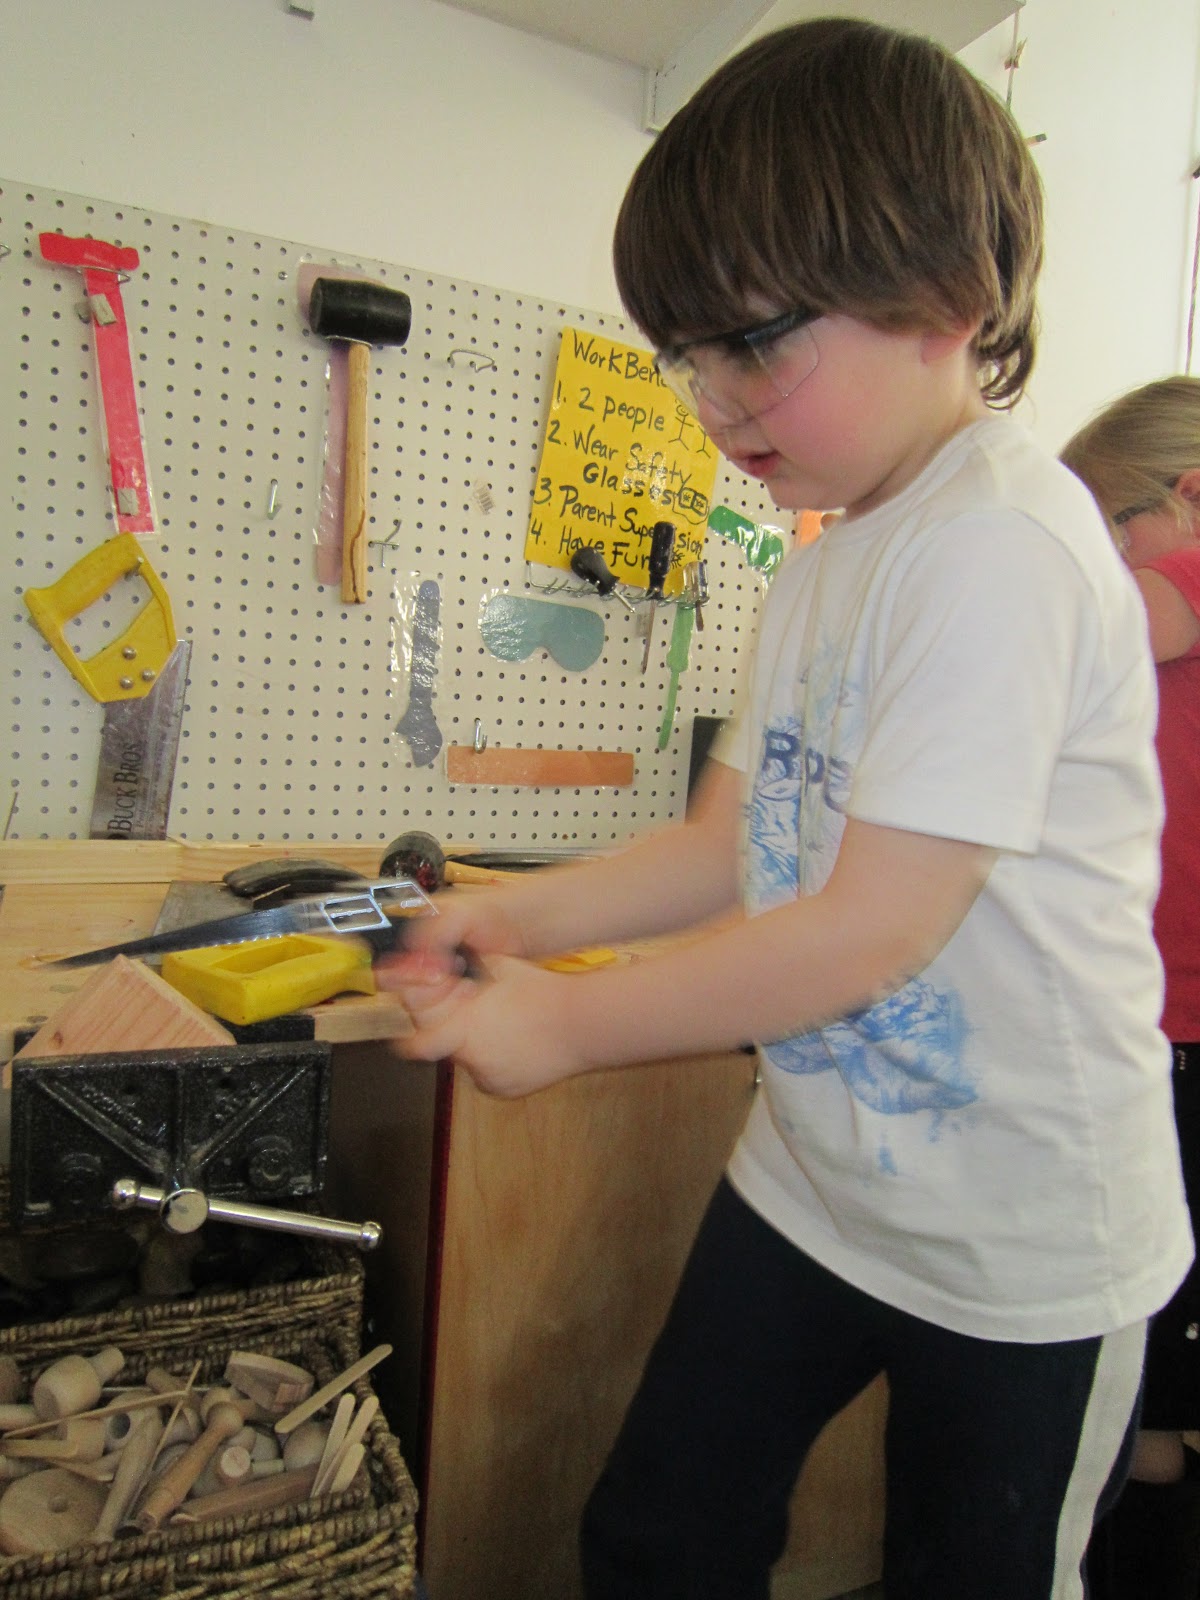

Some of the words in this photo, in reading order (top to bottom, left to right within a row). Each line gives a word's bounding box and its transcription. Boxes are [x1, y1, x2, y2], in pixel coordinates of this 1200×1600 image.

[578, 387, 595, 412] 2
[602, 395, 665, 433] people
[547, 419, 568, 446] 2.
[573, 424, 619, 461] Wear
[625, 442, 693, 496] Safety
[558, 484, 617, 529] Parent
[582, 462, 673, 506] Glasses
[531, 518, 547, 546] 4.
[558, 525, 606, 556] Have
[609, 541, 651, 570] Fun
[106, 787, 137, 833] BUCK
